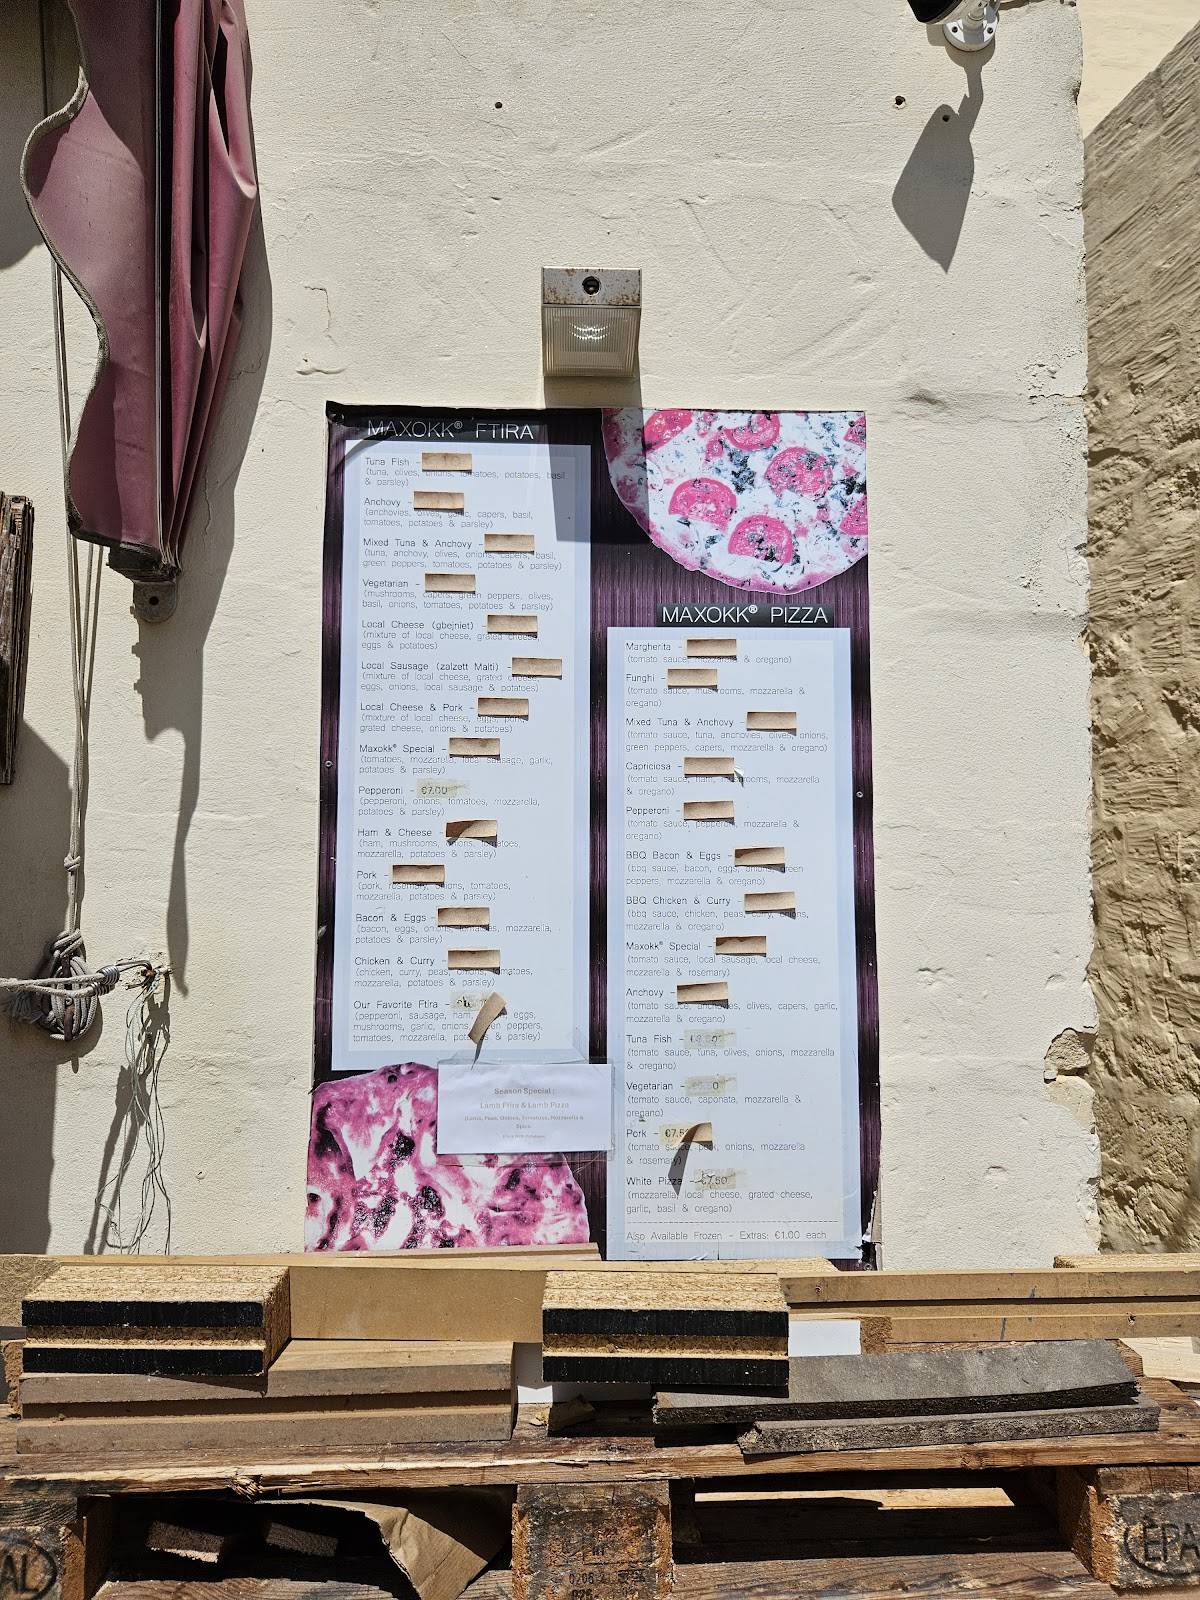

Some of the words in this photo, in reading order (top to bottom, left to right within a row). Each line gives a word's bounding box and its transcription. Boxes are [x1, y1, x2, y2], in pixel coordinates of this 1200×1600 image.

[476, 423, 534, 439] FTIRA
[365, 458, 386, 466] Tuna
[391, 458, 409, 466] Fish
[364, 498, 401, 508] Anchovy
[363, 538, 388, 546] Mixed
[422, 539, 429, 547] &
[435, 539, 472, 549] Anchovy
[362, 579, 409, 589] Vegetarian
[770, 607, 828, 623] PIZZA
[362, 620, 385, 628] Local
[391, 621, 425, 629] Cheese
[626, 643, 671, 652] Margherita
[361, 662, 385, 670] Local
[390, 662, 429, 672] Sausage
[626, 674, 655, 683] Funghi
[360, 703, 384, 711] Local
[390, 703, 424, 711] Cheese
[443, 704, 463, 712] Pork
[626, 718, 651, 726] Mixed
[657, 718, 678, 726] Tuna
[684, 718, 690, 726] &
[697, 718, 734, 728] Anchovy
[403, 745, 435, 754] Special
[358, 786, 403, 796] Pepperoni
[626, 806, 669, 816] Pepperoni
[357, 828, 378, 836] Ham
[384, 828, 391, 836] &
[398, 828, 432, 836] Cheese
[626, 851, 647, 859] BBQ
[652, 851, 680, 859] Bacon
[686, 851, 693, 859] &
[699, 852, 721, 861] Eggs
[626, 896, 647, 904] BBQ
[652, 896, 687, 904] Chicken
[694, 896, 700, 904] &
[706, 896, 731, 906] Curry
[404, 914, 426, 923] Eggs
[669, 942, 701, 952] Special
[354, 957, 390, 965] Chicken
[396, 957, 404, 965] &
[410, 957, 434, 966] Curry
[626, 988, 664, 998] Anchovy
[353, 1000, 371, 1008] Our
[376, 1000, 412, 1008] Favorite
[418, 1000, 438, 1008] Ftira
[626, 1035, 647, 1043] Tuna
[653, 1035, 672, 1043] Fish
[626, 1082, 673, 1091] Vegetarian
[626, 1129, 647, 1137] Pork
[626, 1177, 651, 1185] White
[658, 1177, 683, 1185] Pizza
[626, 1232, 646, 1240] Also
[694, 1231, 722, 1239] Frozen
[739, 1231, 769, 1239] Extras:
[774, 1231, 800, 1239] €1.00
[806, 1231, 826, 1239] each
